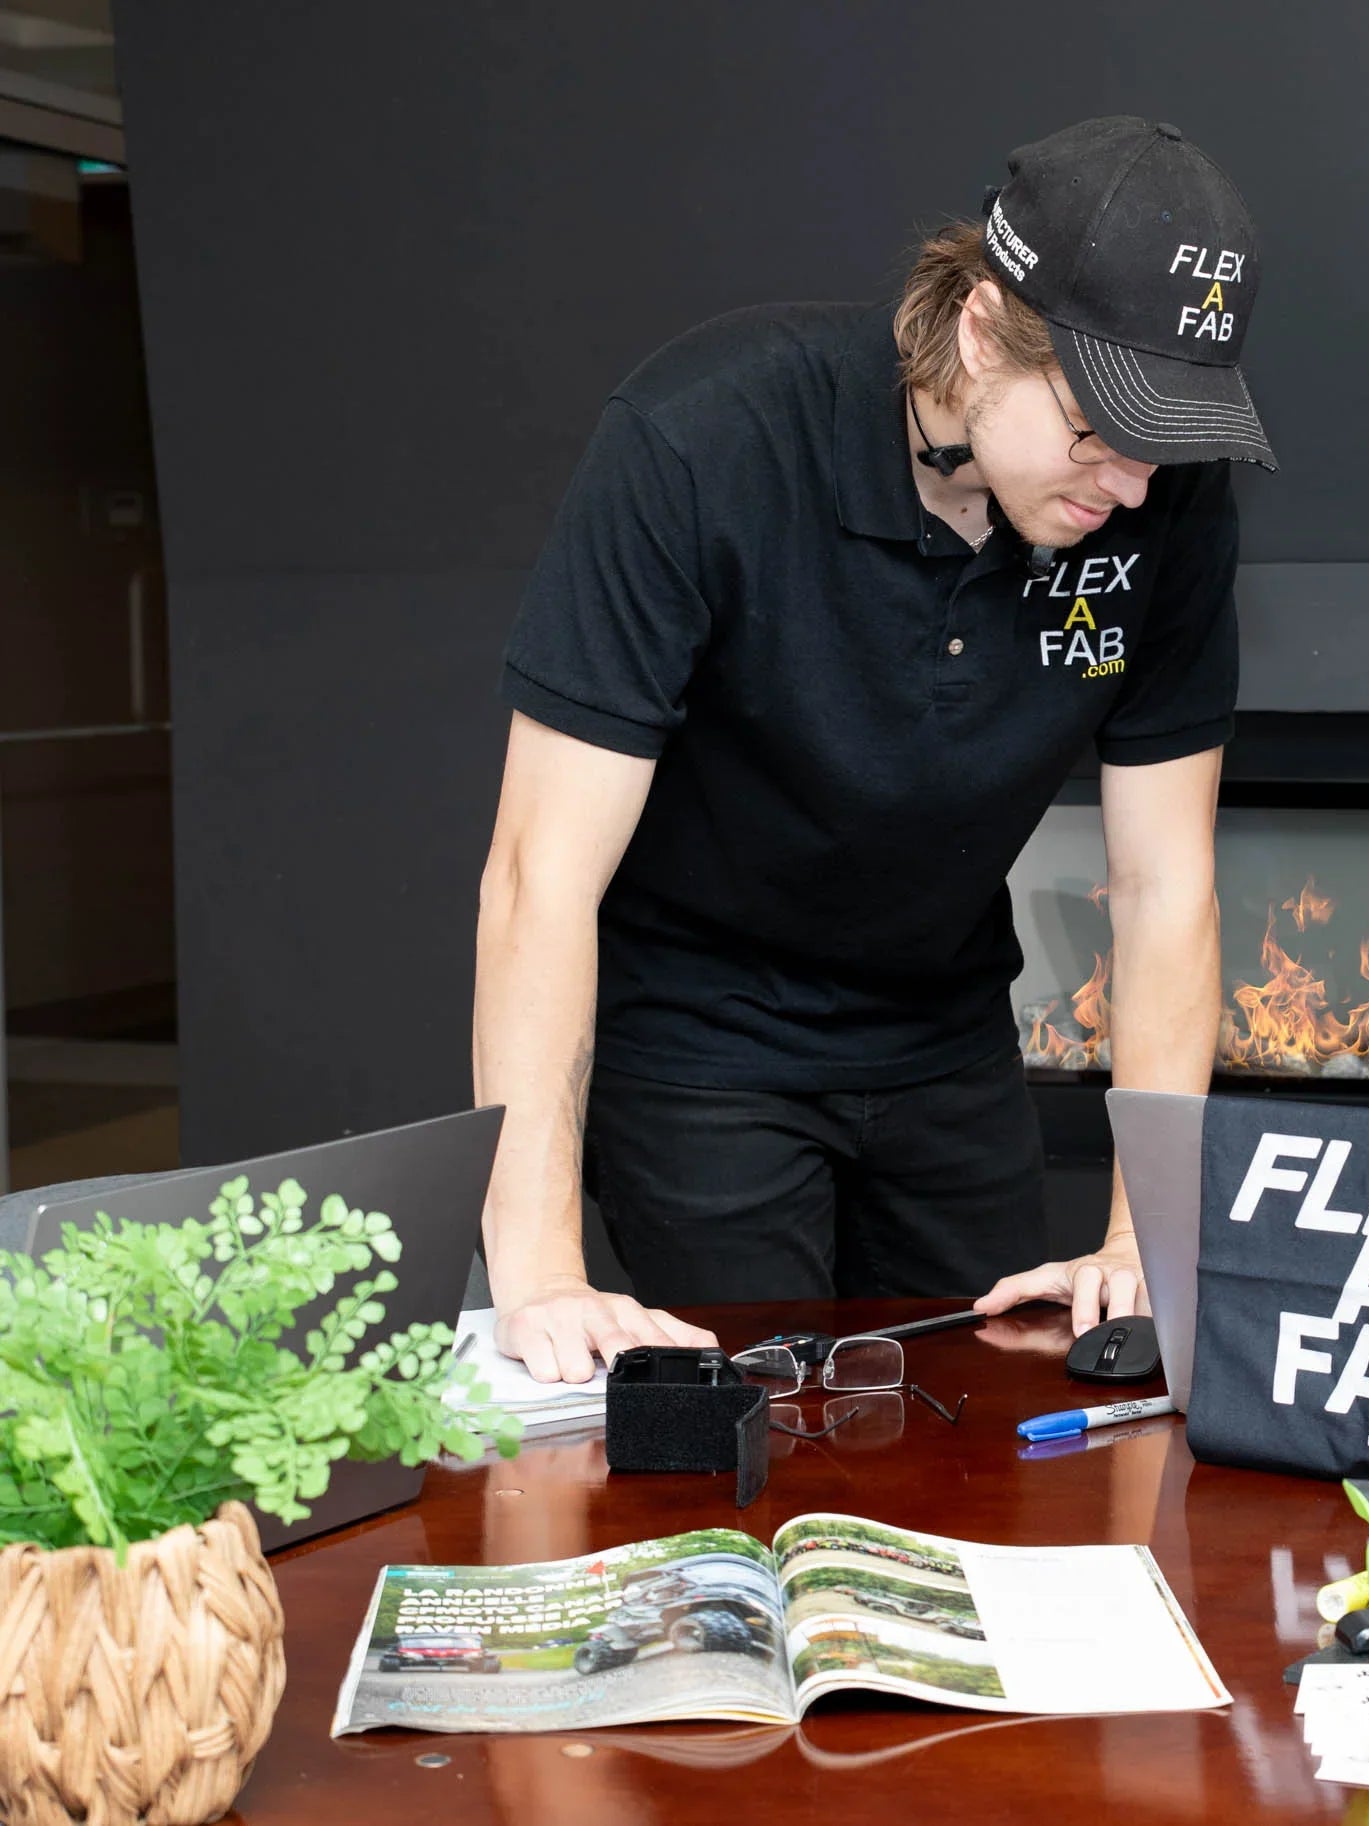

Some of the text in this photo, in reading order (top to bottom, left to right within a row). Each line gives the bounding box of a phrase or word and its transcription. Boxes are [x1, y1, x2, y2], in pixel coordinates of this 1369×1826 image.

[987, 233, 1026, 282] Products
[1169, 244, 1245, 283] FLEX
[1201, 281, 1224, 312] A
[1177, 305, 1234, 342] FAB
[1022, 553, 1141, 598] FLEX
[1063, 596, 1097, 631] A
[1040, 626, 1125, 667] FAB
[1081, 659, 1126, 679] .com
[403, 1588, 440, 1598] LA
